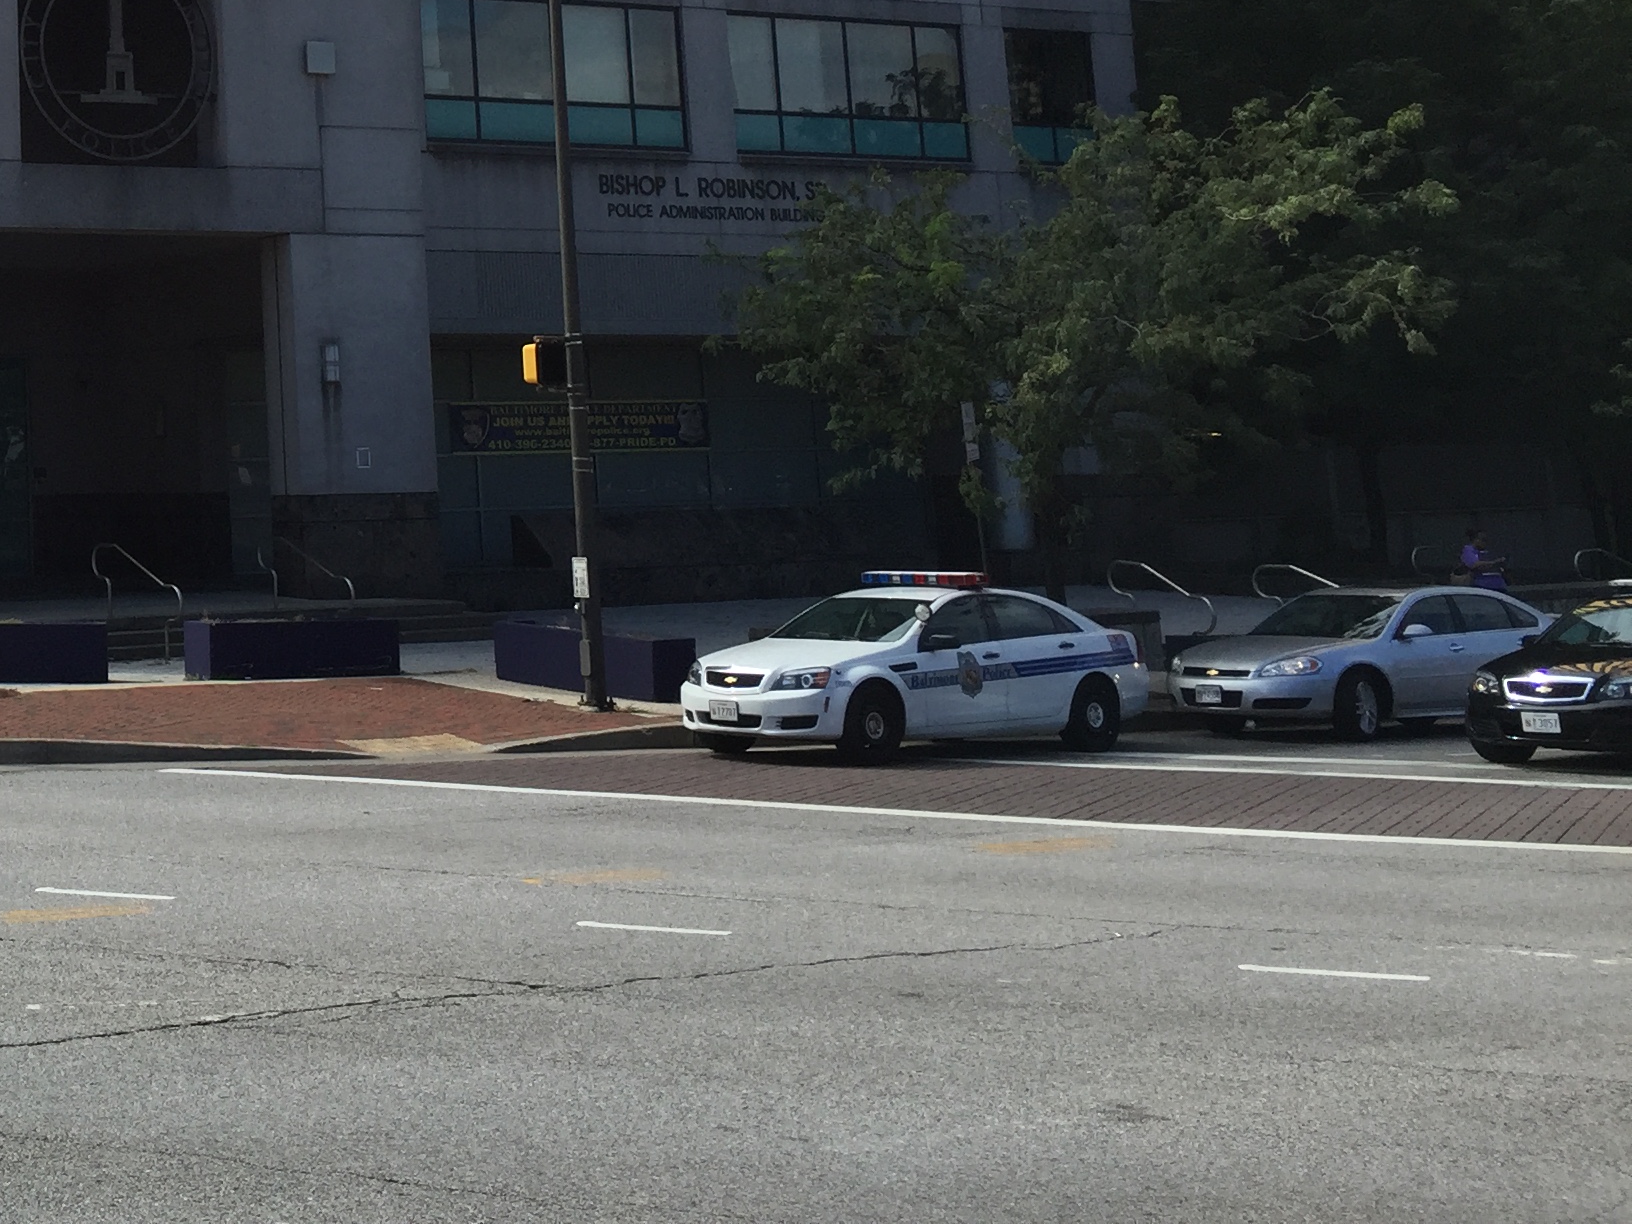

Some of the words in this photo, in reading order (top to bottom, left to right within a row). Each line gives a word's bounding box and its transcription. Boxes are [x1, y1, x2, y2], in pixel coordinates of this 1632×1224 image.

[599, 174, 667, 197] BISHOP
[674, 177, 689, 198] L.
[697, 177, 800, 202] ROBINSON,
[607, 203, 653, 219] POLICE
[659, 205, 766, 221] ADMINISTRATION
[493, 416, 524, 427] JOIN
[527, 416, 545, 427] US
